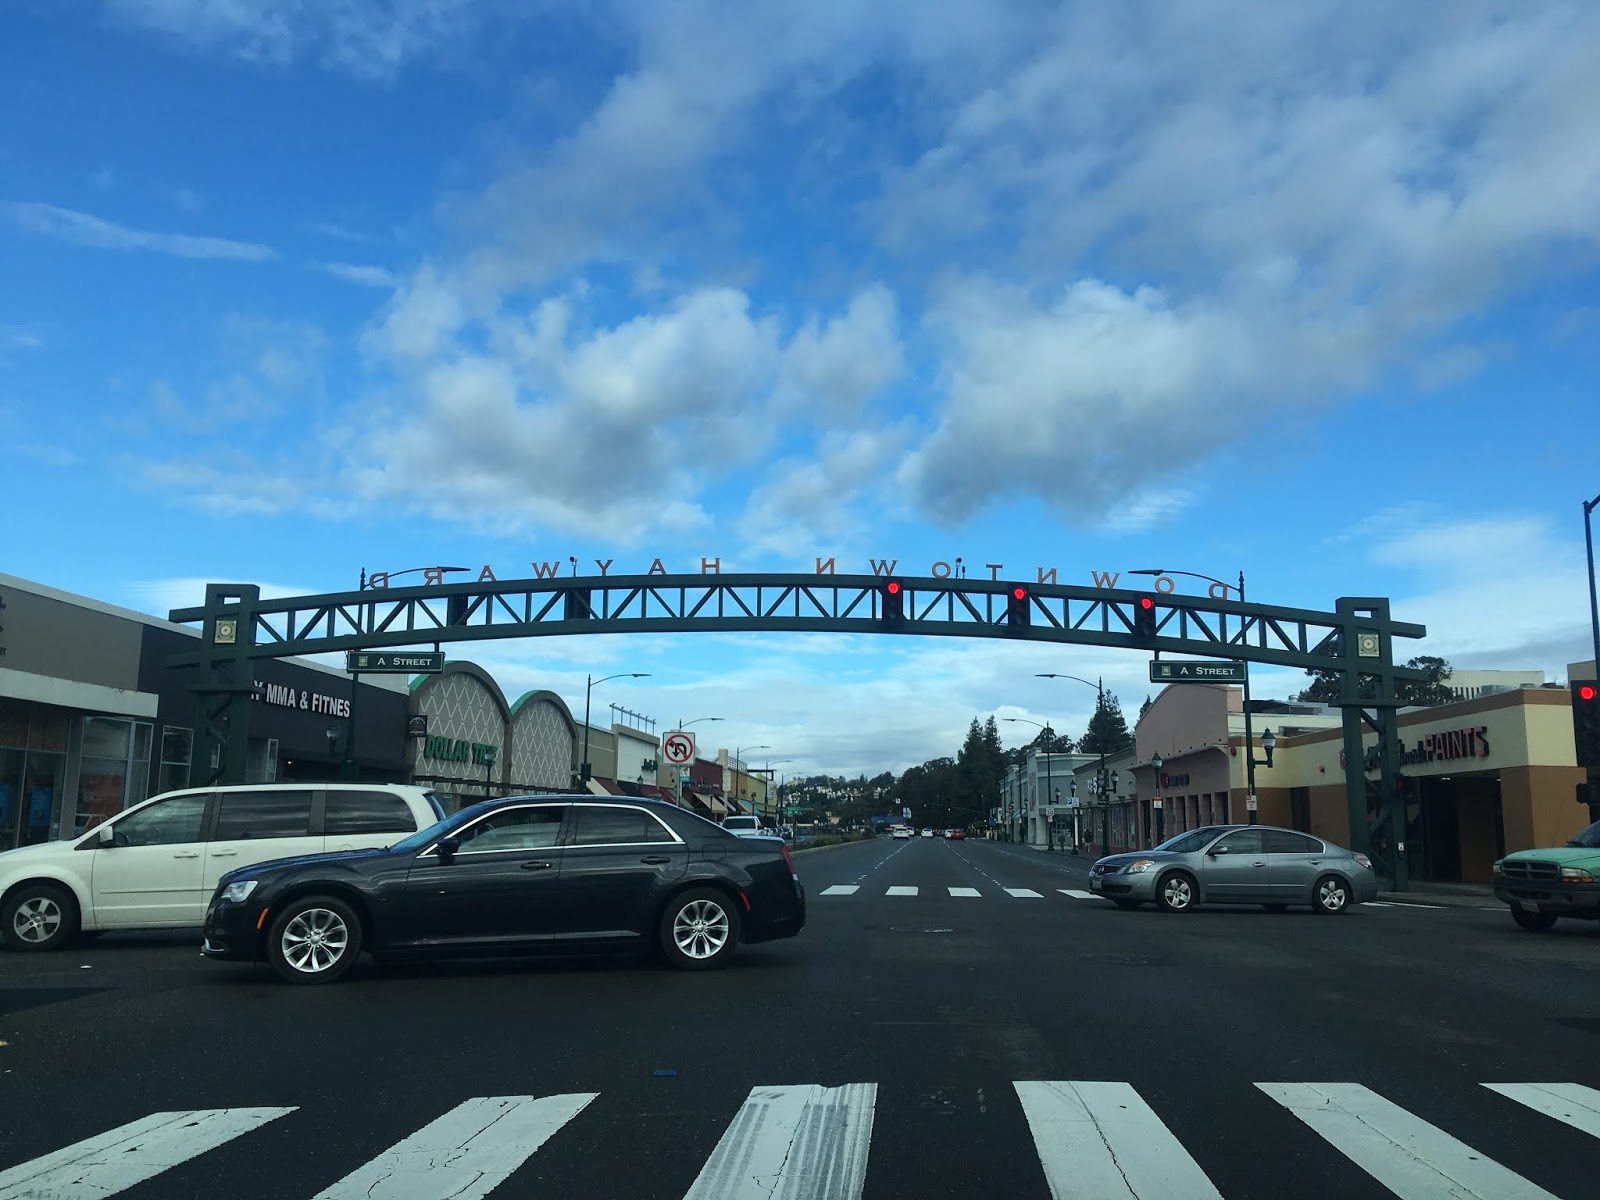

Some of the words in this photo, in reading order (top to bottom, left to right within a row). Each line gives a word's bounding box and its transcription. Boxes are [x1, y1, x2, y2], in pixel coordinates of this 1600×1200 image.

[377, 657, 386, 666] A
[393, 657, 433, 667] STREET
[1180, 666, 1189, 675] A
[1196, 667, 1235, 676] STREET
[266, 683, 296, 708] MMA
[300, 690, 308, 710] &
[312, 693, 351, 718] FITNES
[424, 735, 470, 763] DOLLAR
[471, 742, 498, 767] TRE
[1424, 726, 1489, 762] PAINTS
